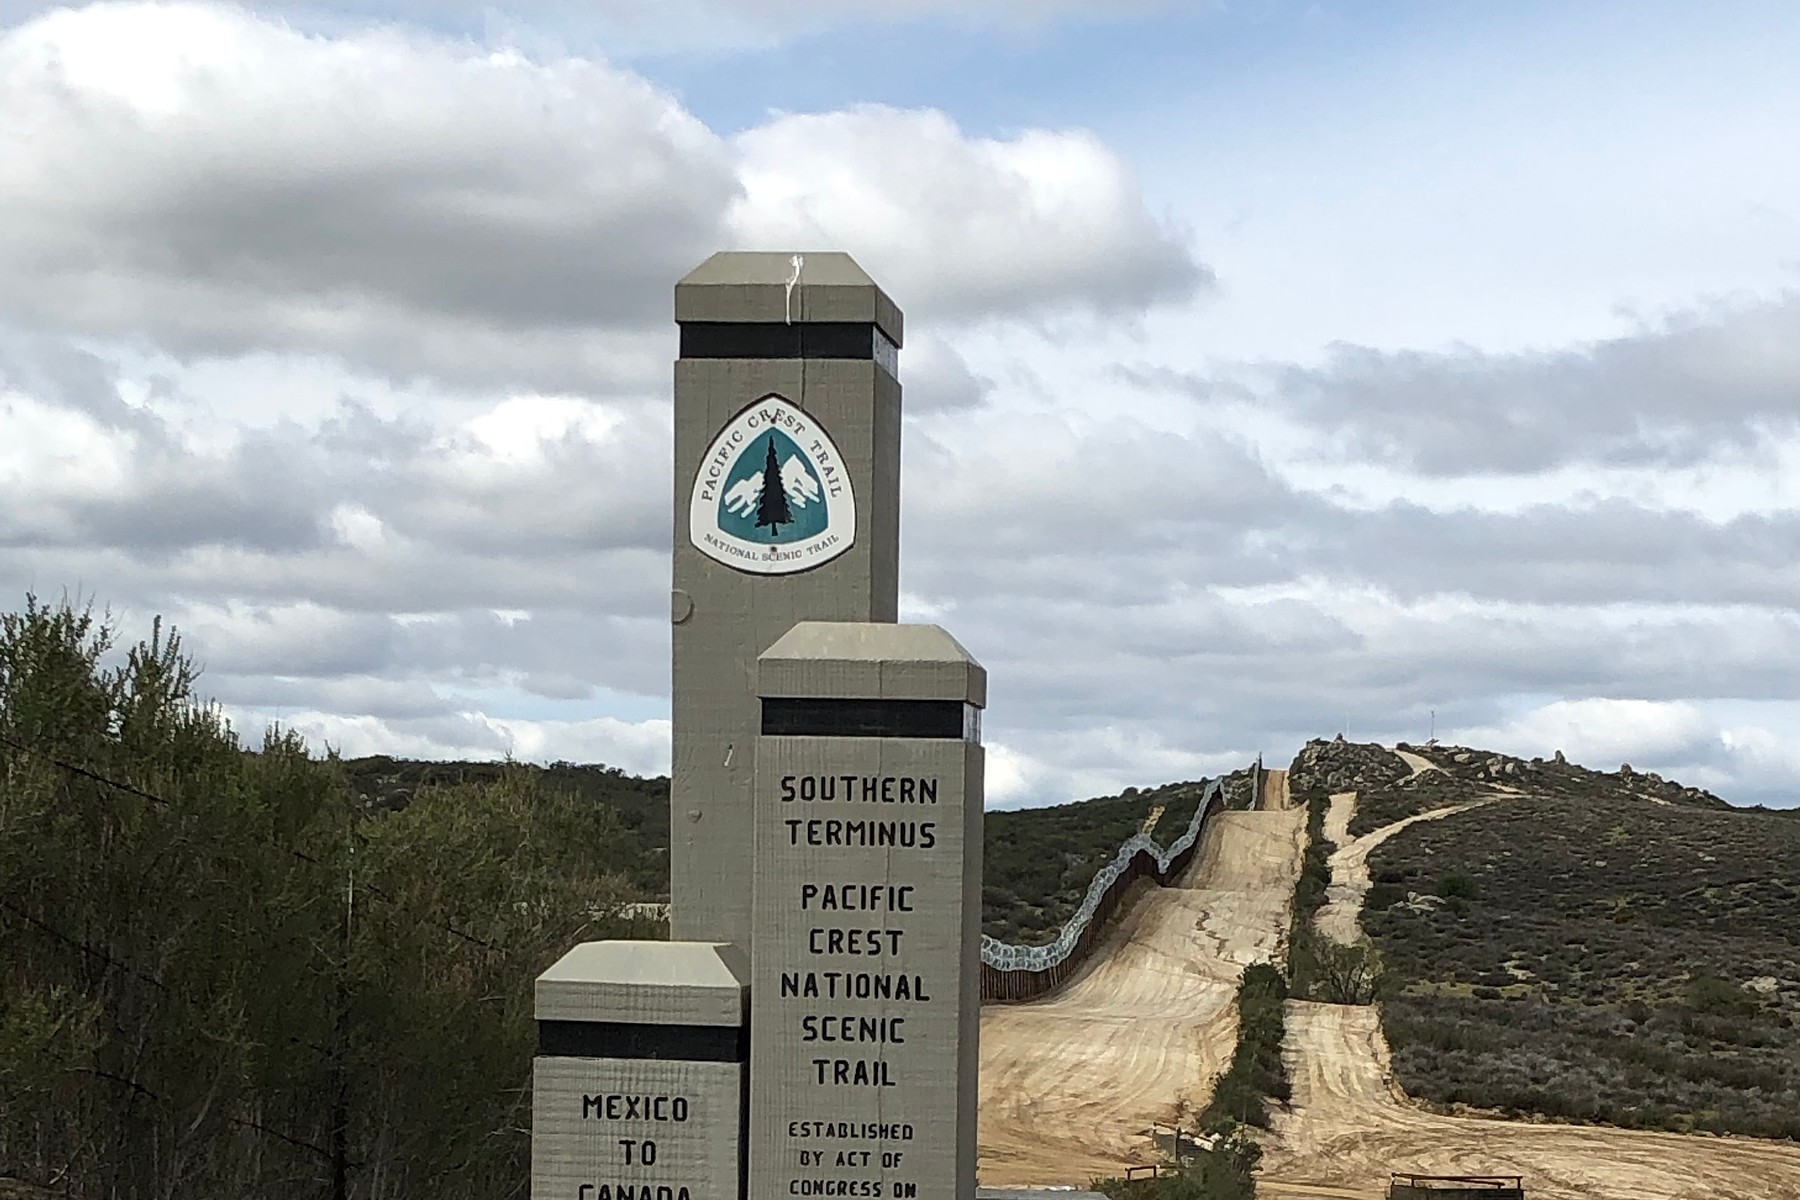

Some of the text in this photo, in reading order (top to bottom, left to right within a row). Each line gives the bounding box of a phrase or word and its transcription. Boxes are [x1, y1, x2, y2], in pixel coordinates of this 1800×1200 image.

[701, 408, 842, 501] PACIFIC CREST TRAIL
[704, 533, 840, 562] NATIONAL SCENIC TRAIL
[781, 776, 937, 804] SOUTHERN
[785, 820, 936, 849] TERMINUS
[802, 885, 914, 912] PACIFIC
[809, 929, 904, 956] CREST
[781, 973, 930, 1001] NATIONAL
[802, 1016, 905, 1043] SCENIC
[812, 1060, 896, 1087] TRAIL
[582, 1094, 688, 1122] MEXICO
[788, 1122, 914, 1140] ESTABLISHED
[619, 1140, 656, 1166] TO
[800, 1151, 903, 1168] BY ACT OF
[790, 1179, 917, 1199] CONGRESS ON
